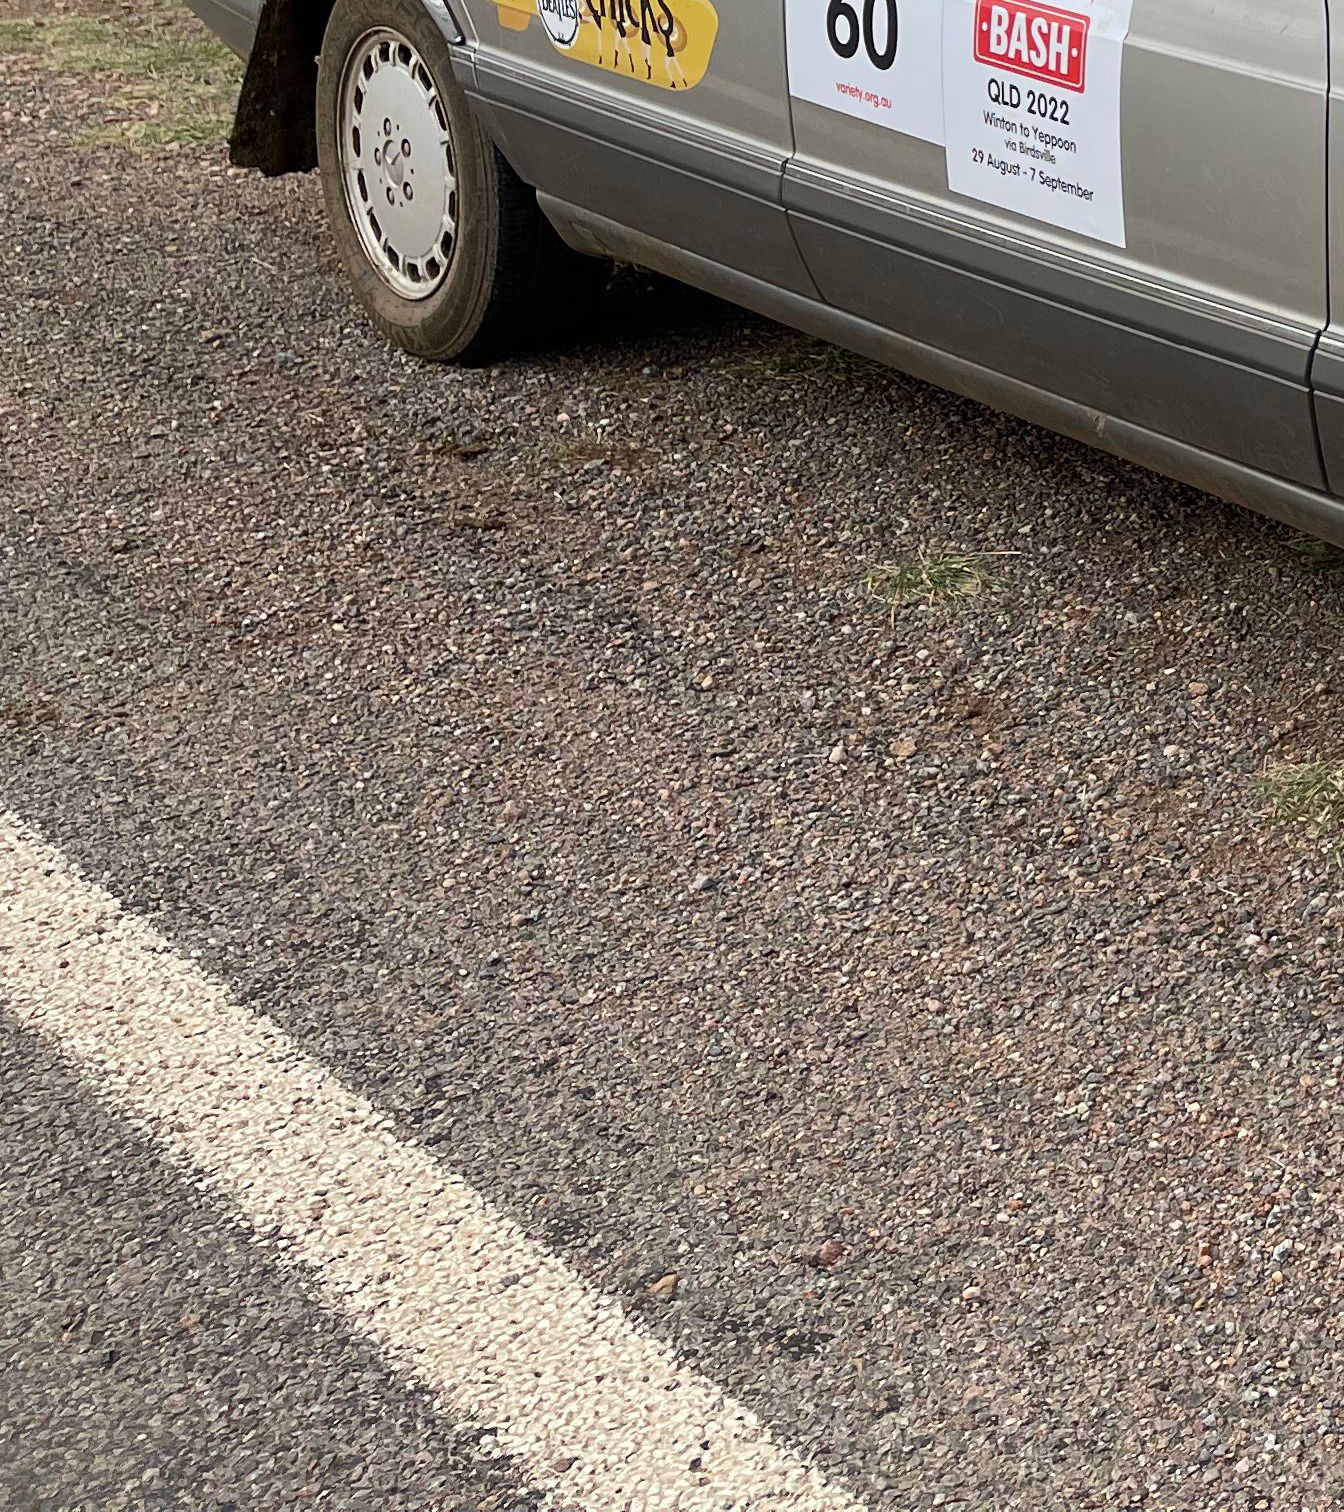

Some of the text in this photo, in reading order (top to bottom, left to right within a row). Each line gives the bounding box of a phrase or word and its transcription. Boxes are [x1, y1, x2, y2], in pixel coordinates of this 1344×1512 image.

[989, 4, 1071, 75] BASH
[835, 81, 893, 110] variety.org.au
[987, 78, 1070, 126] QLD 2022
[982, 109, 1078, 154] Winton to Yeppoon
[1005, 138, 1057, 165] via Birdsville
[971, 147, 985, 164] 29
[986, 153, 1022, 176] August
[1029, 166, 1037, 182] 7
[1038, 170, 1095, 202] September
